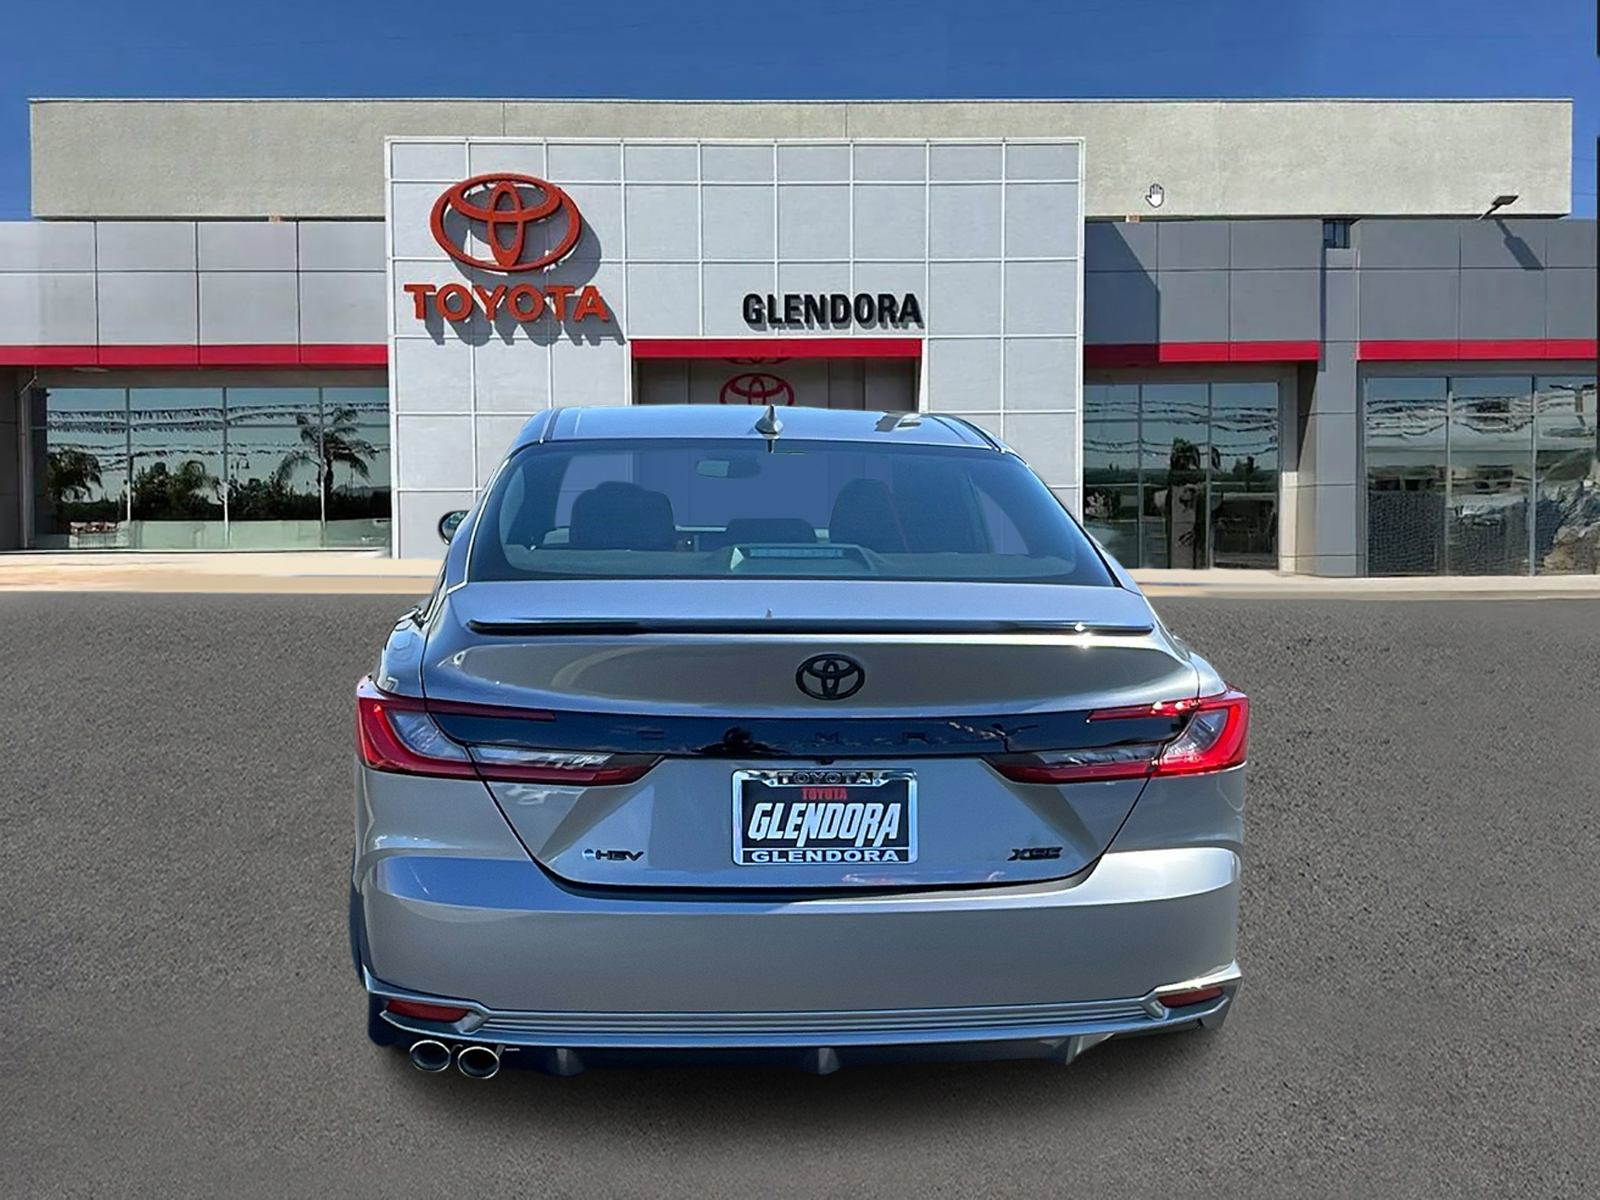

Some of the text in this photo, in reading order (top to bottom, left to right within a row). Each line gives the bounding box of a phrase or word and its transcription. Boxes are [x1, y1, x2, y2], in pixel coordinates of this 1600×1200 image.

[404, 283, 610, 322] TOYOTA
[743, 293, 924, 325] GLENDORA
[778, 772, 872, 785] TOYOTA
[802, 787, 847, 800] TOYOTA
[748, 803, 901, 847] GLENDORA
[751, 850, 900, 863] GLENDORA
